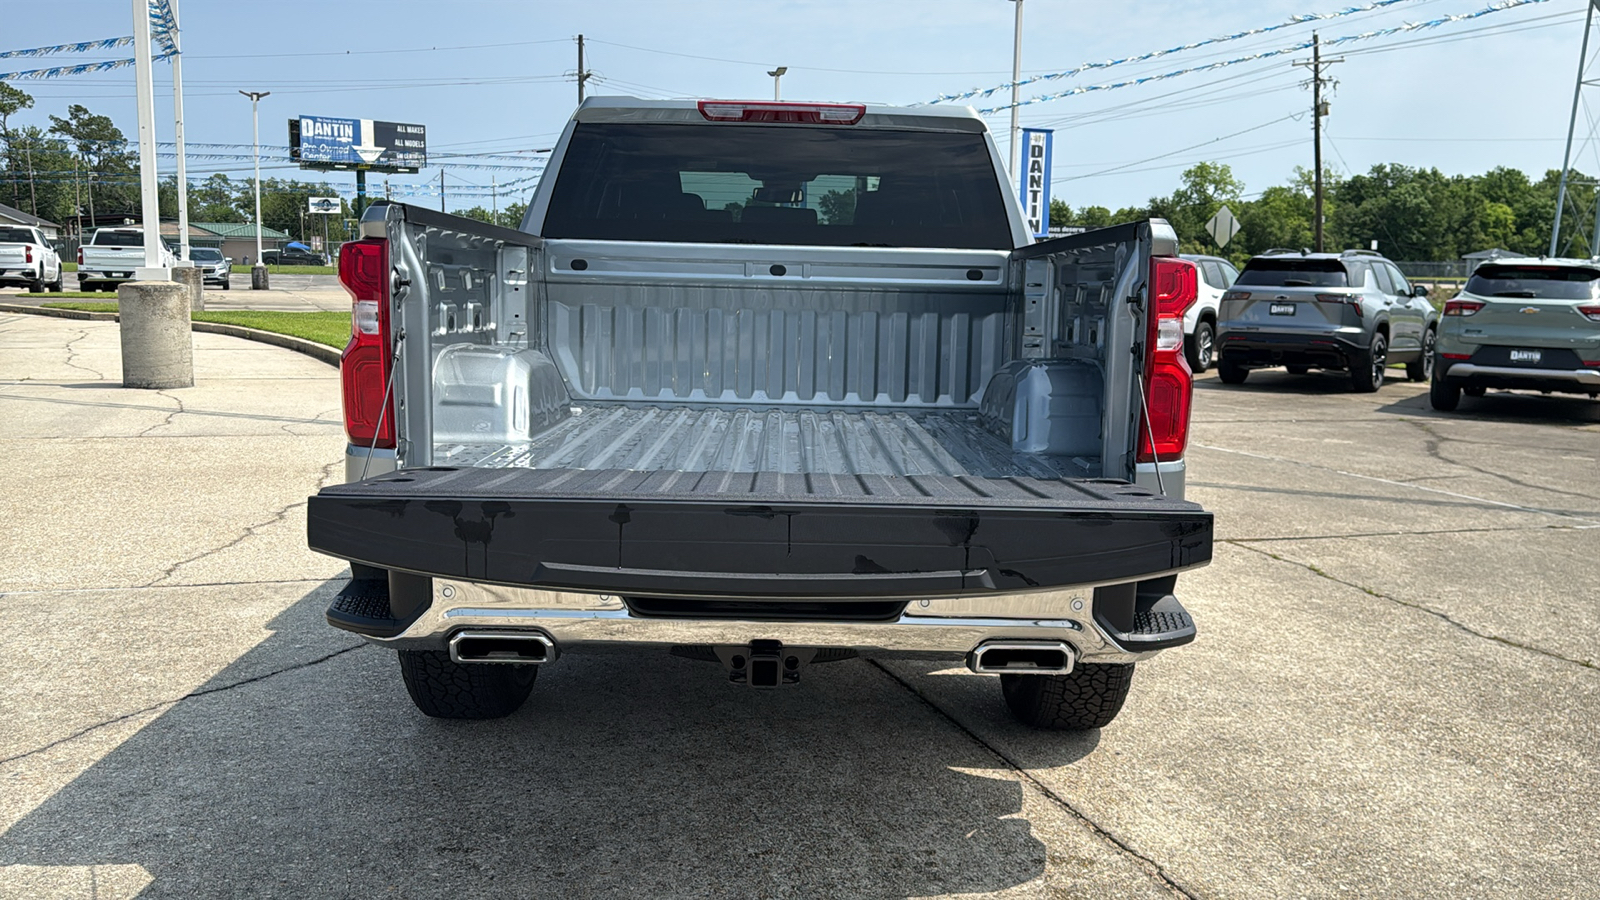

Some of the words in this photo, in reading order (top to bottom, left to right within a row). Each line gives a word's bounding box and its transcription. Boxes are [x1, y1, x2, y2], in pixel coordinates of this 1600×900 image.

[301, 118, 353, 138] DANTIN
[396, 125, 406, 133] ALL
[406, 125, 424, 134] MAKES
[394, 138, 404, 147] ALL
[404, 139, 425, 148] MODELS
[1028, 145, 1043, 233] DANTIN
[1510, 350, 1541, 361] DANTIN
